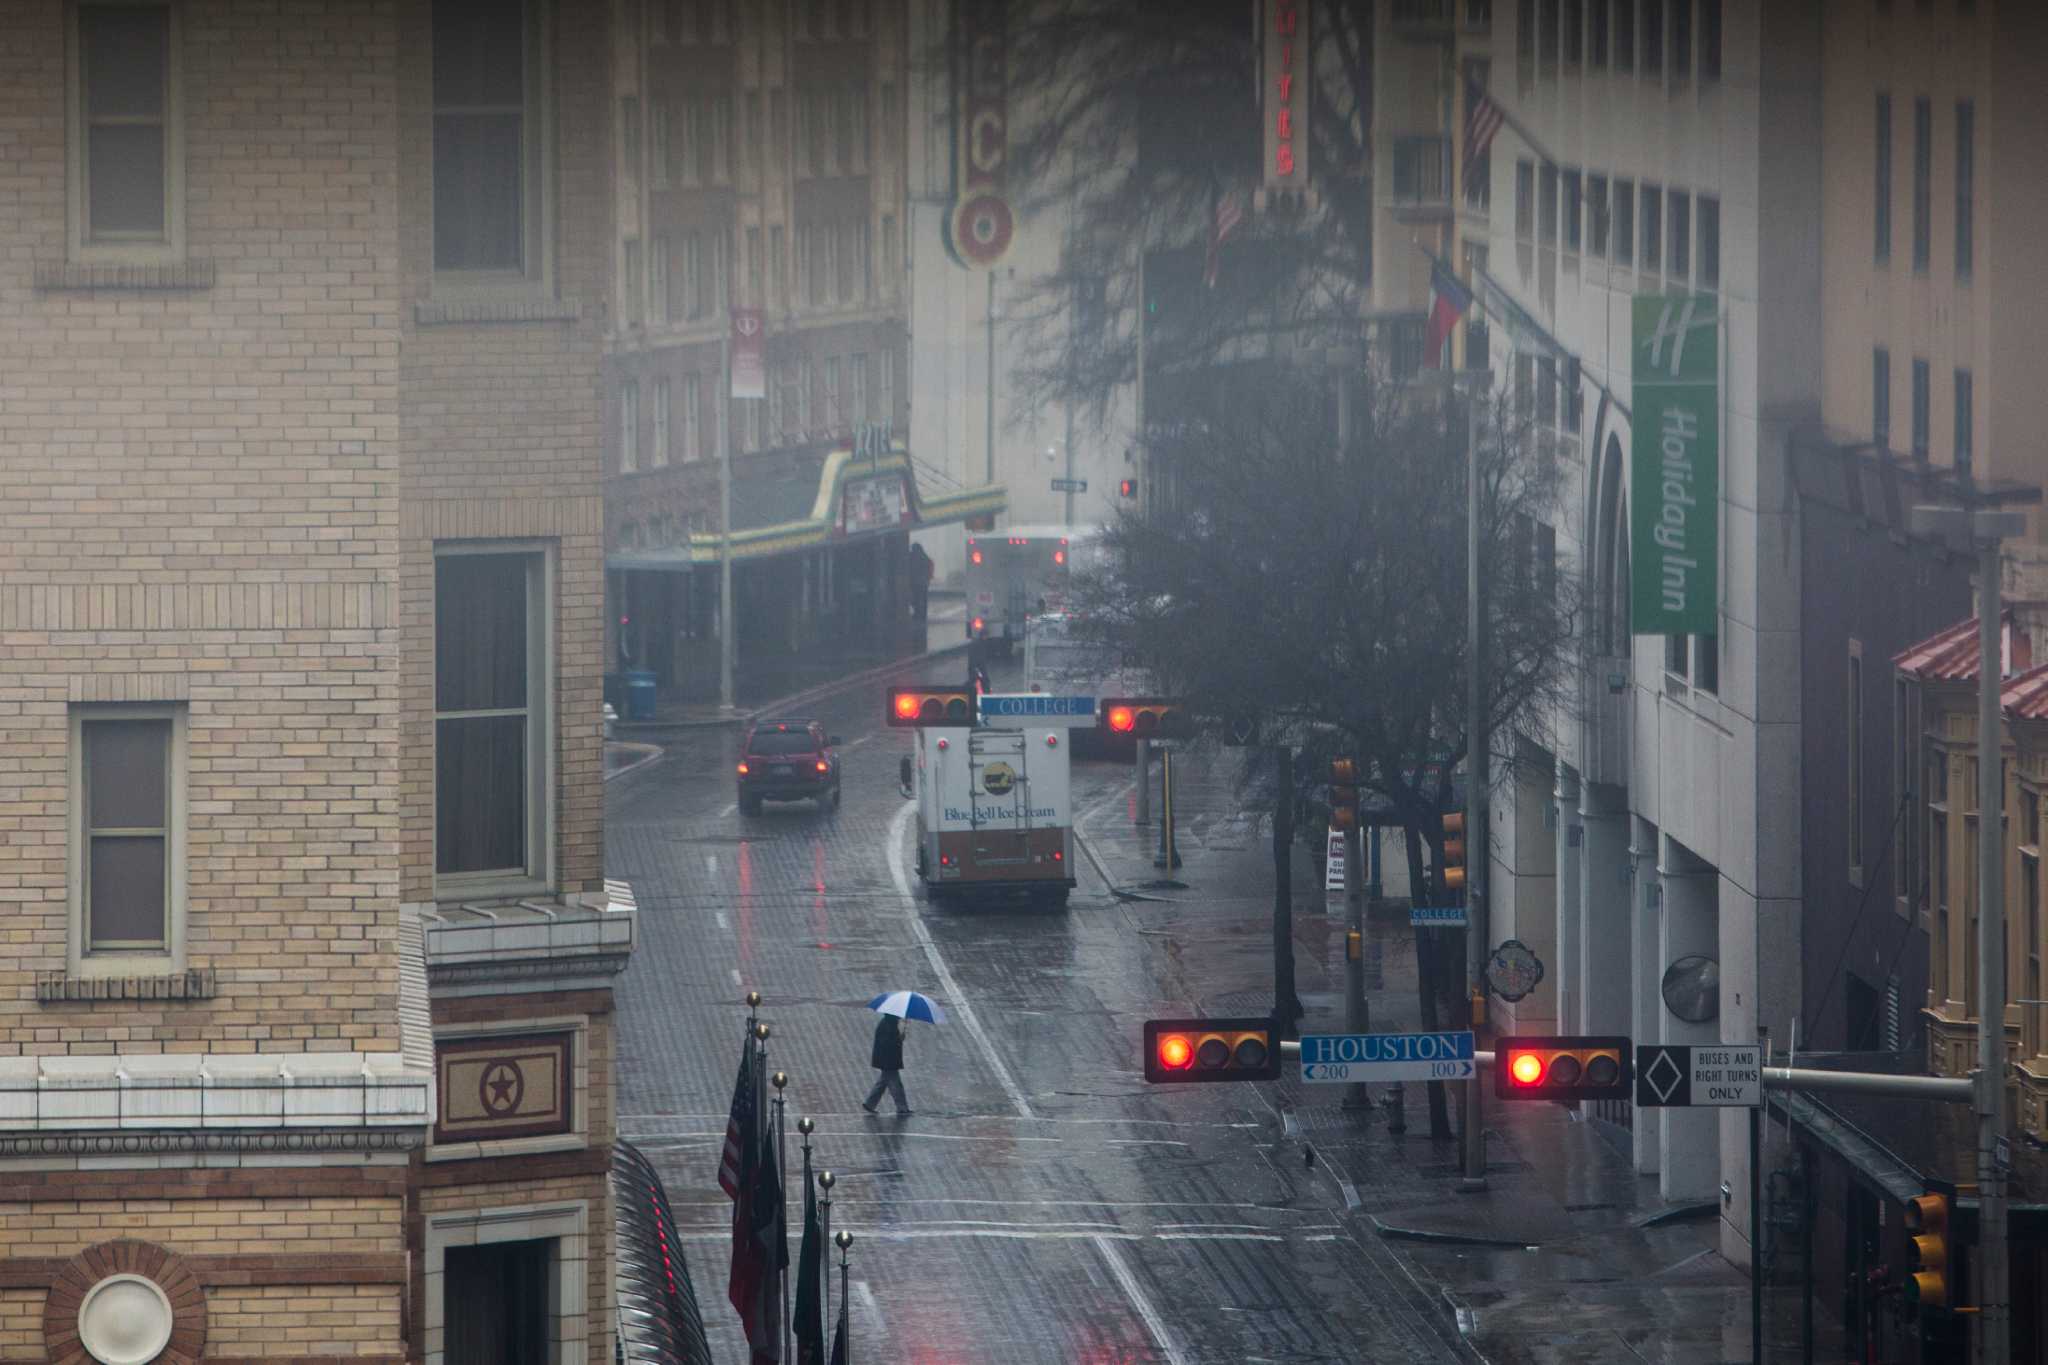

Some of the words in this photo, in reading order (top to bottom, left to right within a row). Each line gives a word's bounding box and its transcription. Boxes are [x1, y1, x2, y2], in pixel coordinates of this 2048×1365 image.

[1654, 406, 1697, 549] Holiday
[1662, 555, 1697, 611] Inn
[1000, 699, 1076, 714] COLLEGE
[975, 806, 995, 819] Bell
[997, 806, 1014, 818] Ice
[1412, 910, 1465, 919] COLLEGE
[1315, 1034, 1461, 1062] HOUSTON
[1698, 1052, 1729, 1065] BUSES
[1734, 1052, 1754, 1065] AND
[1319, 1064, 1349, 1080] 200
[1431, 1062, 1456, 1078] 100
[1695, 1070, 1721, 1082] RIGHT
[1727, 1070, 1758, 1082] TURNS
[1708, 1087, 1743, 1100] ONLY
